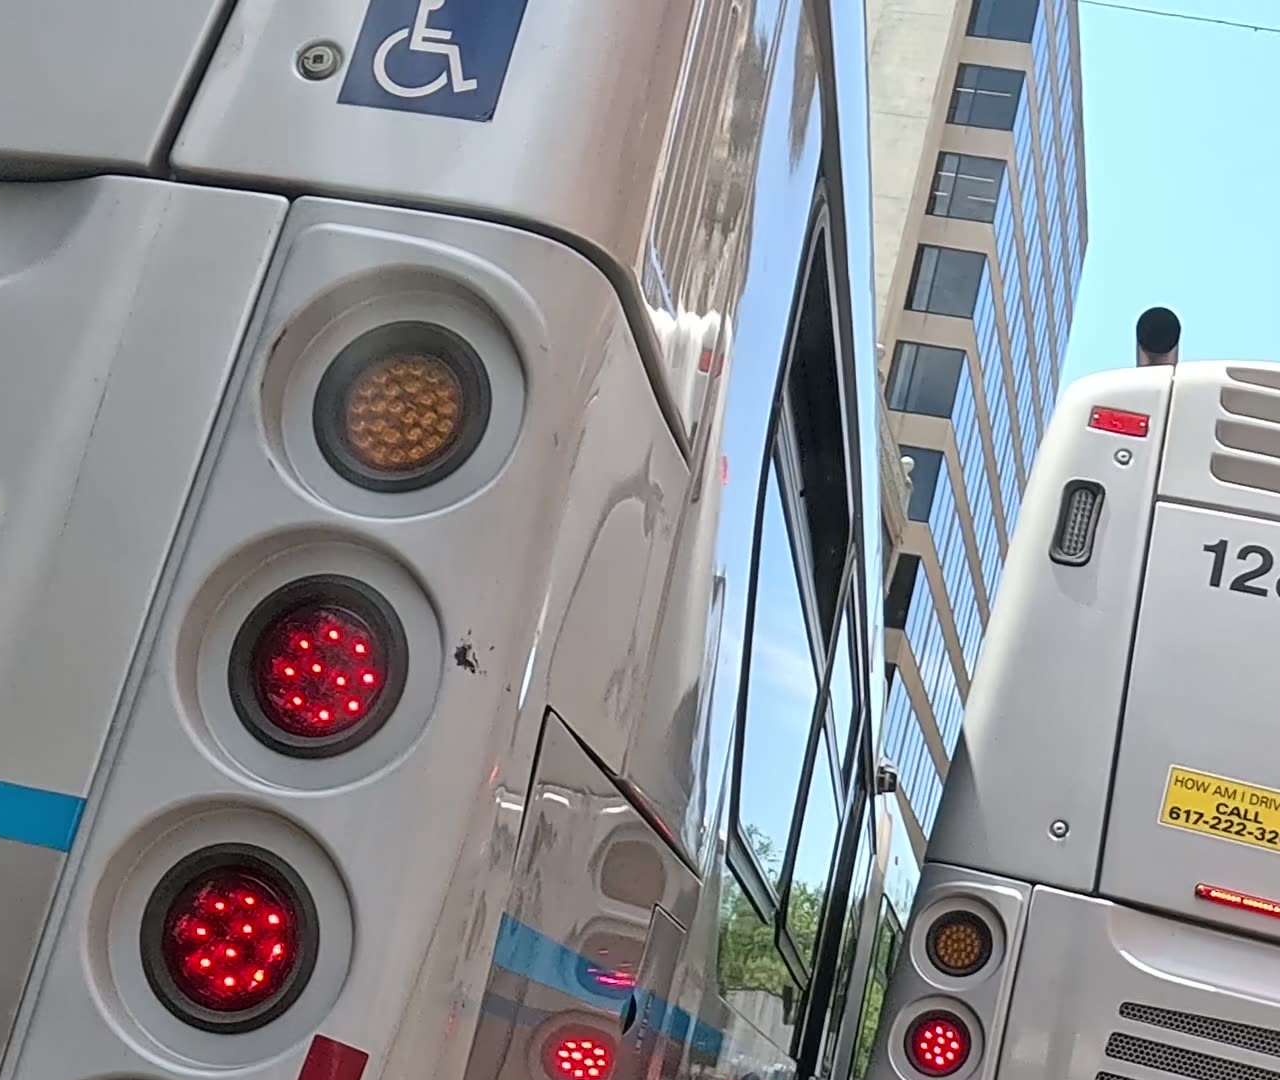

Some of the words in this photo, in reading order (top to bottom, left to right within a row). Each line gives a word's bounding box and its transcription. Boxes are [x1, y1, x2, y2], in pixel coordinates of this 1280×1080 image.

[1174, 775, 1211, 793] HOW
[1212, 785, 1237, 800] AM
[1240, 792, 1246, 802] I
[1215, 802, 1263, 824] CALL
